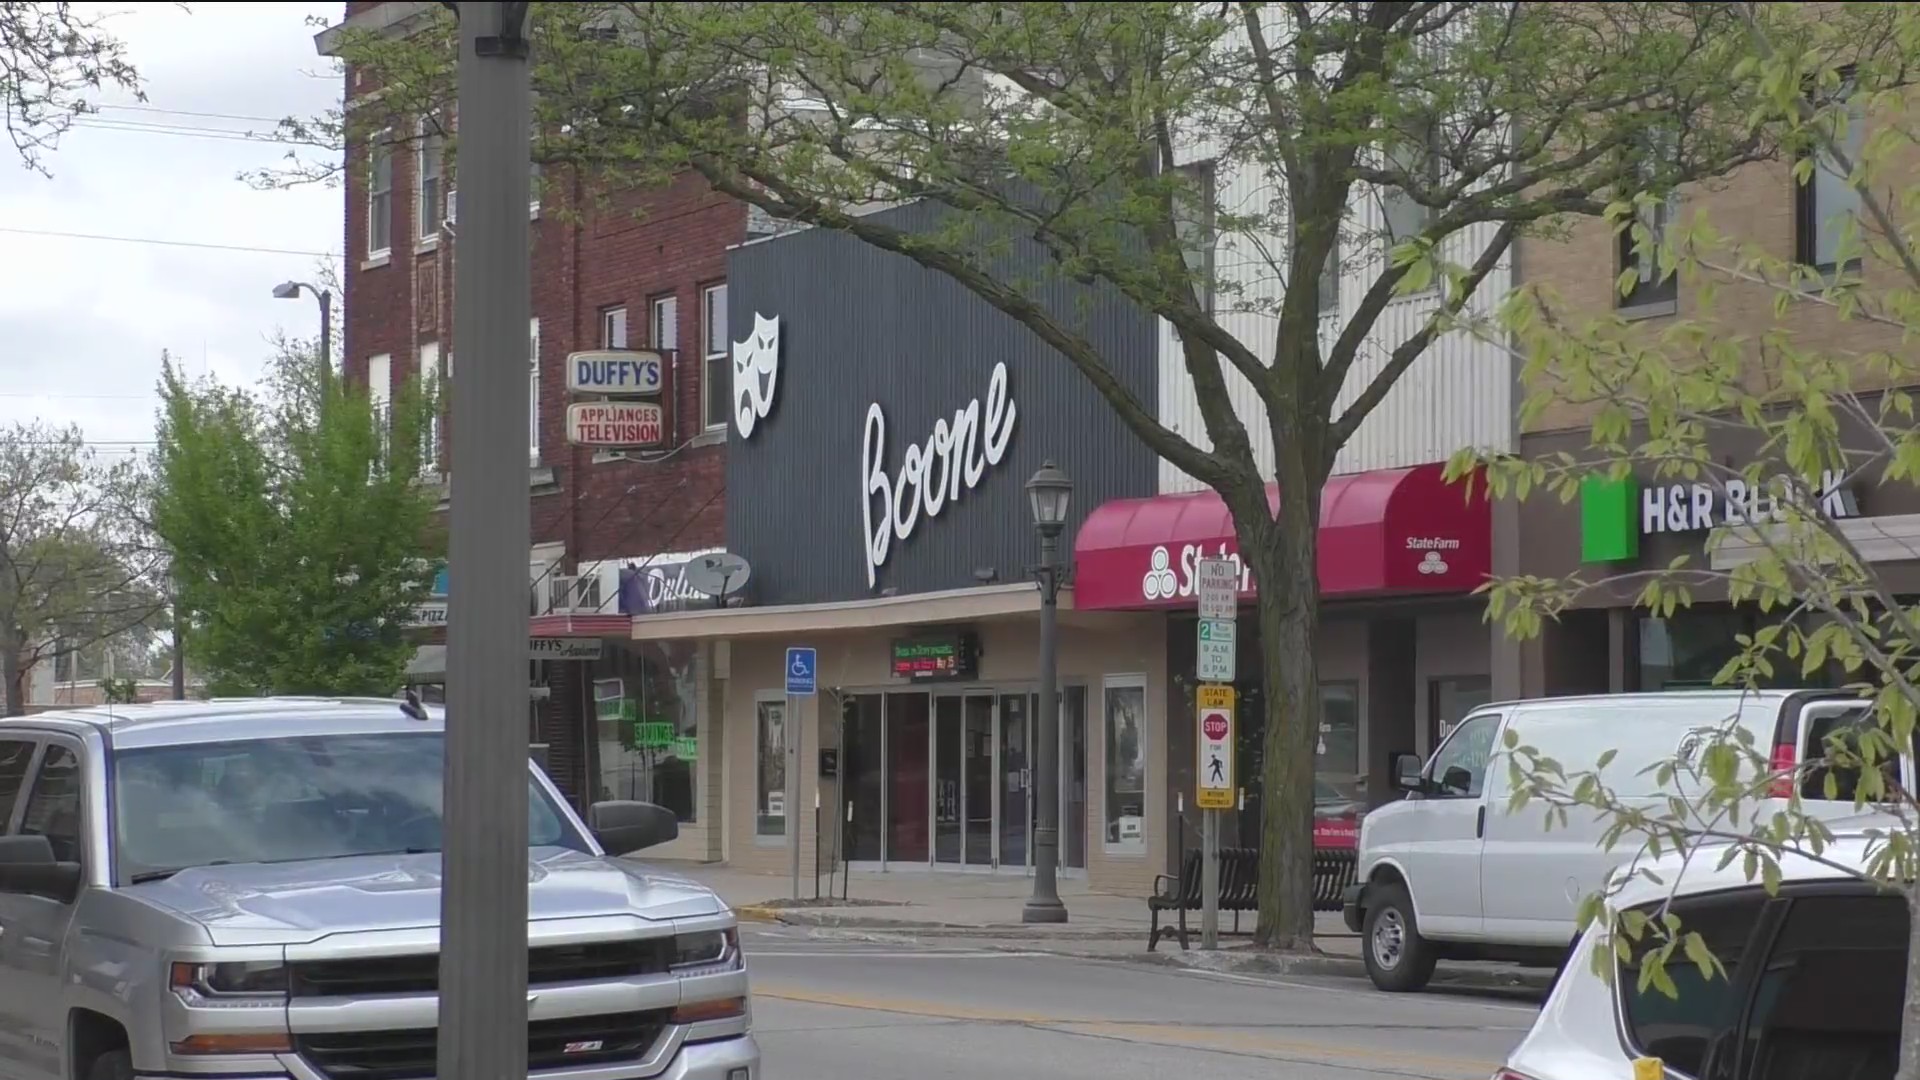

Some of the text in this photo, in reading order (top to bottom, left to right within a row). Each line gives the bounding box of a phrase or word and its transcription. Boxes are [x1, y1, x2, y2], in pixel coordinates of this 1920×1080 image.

[577, 359, 660, 387] DUFFY'S
[580, 408, 659, 423] APPLIANCES
[577, 424, 660, 441] TELEVISION
[862, 361, 1016, 589] Boone
[1643, 468, 1847, 534] H&R BLOK
[1211, 564, 1225, 577] NO
[1202, 577, 1234, 590] PARKING
[422, 610, 448, 621] PIZZ
[1201, 623, 1210, 639] 2
[1211, 655, 1222, 663] TO
[1204, 689, 1227, 697] STATE
[1205, 721, 1227, 732] STOP
